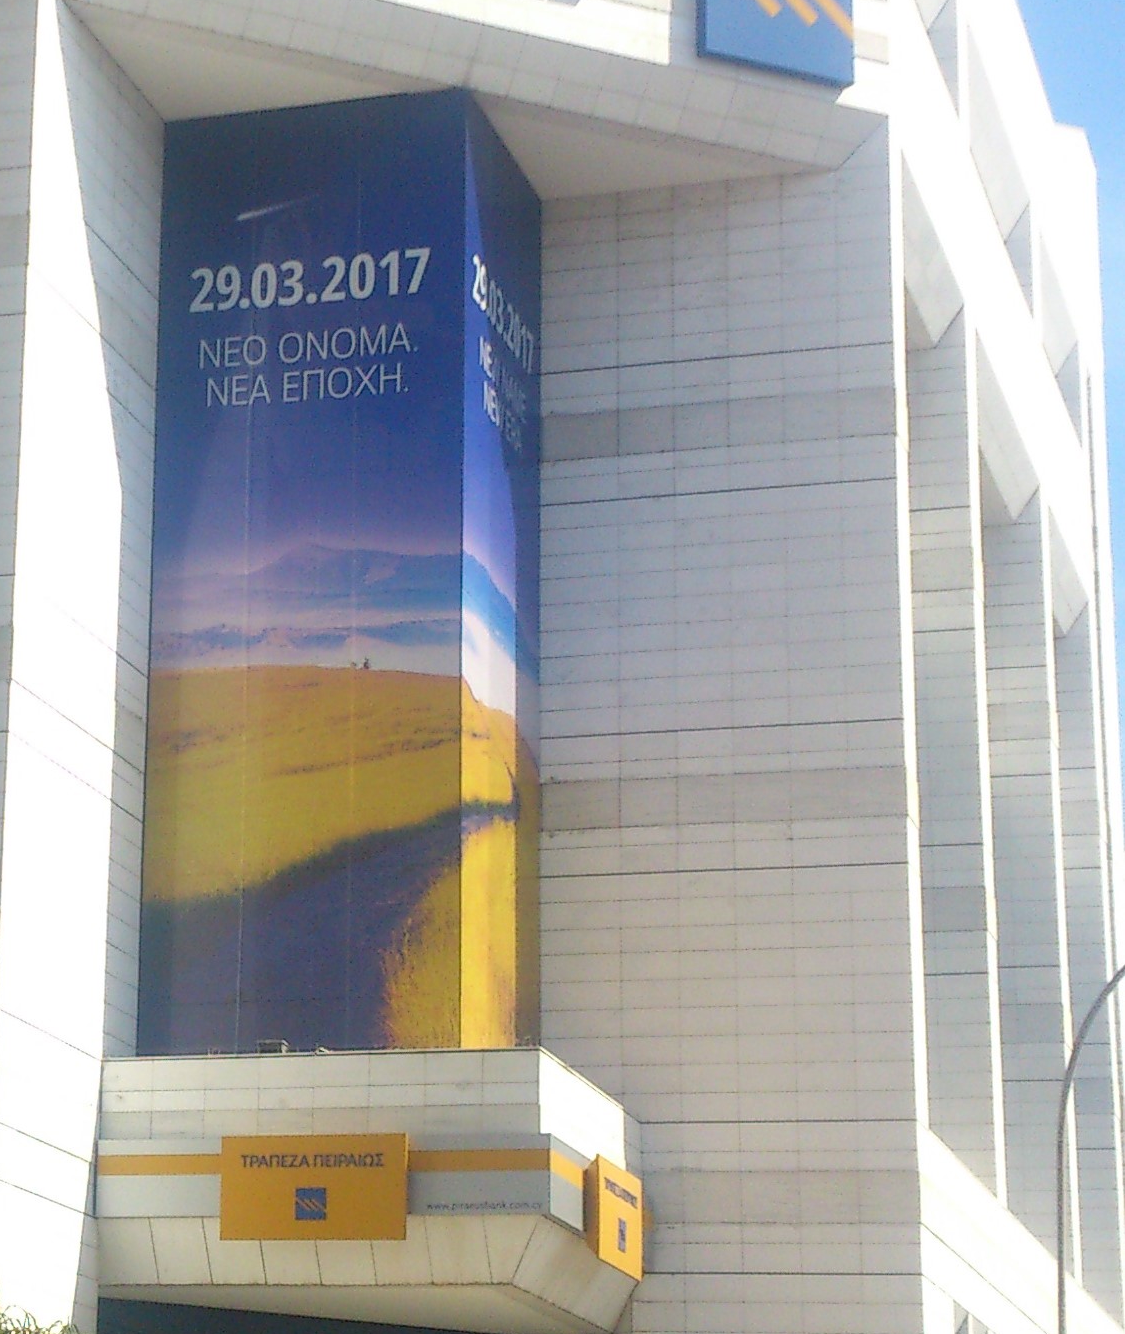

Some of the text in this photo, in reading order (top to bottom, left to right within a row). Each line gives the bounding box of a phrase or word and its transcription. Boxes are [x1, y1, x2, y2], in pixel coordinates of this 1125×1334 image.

[188, 247, 431, 313] 29.03.2017
[198, 322, 419, 369] ΝΕΟ ΟΝΟΜΑ.
[206, 362, 410, 408] ΝΕΑ ΕΠΟΧΗ.
[241, 1152, 385, 1168] ΤΡΑΠΕΖΑ ΠΕΙΡΑΙΩΣ
